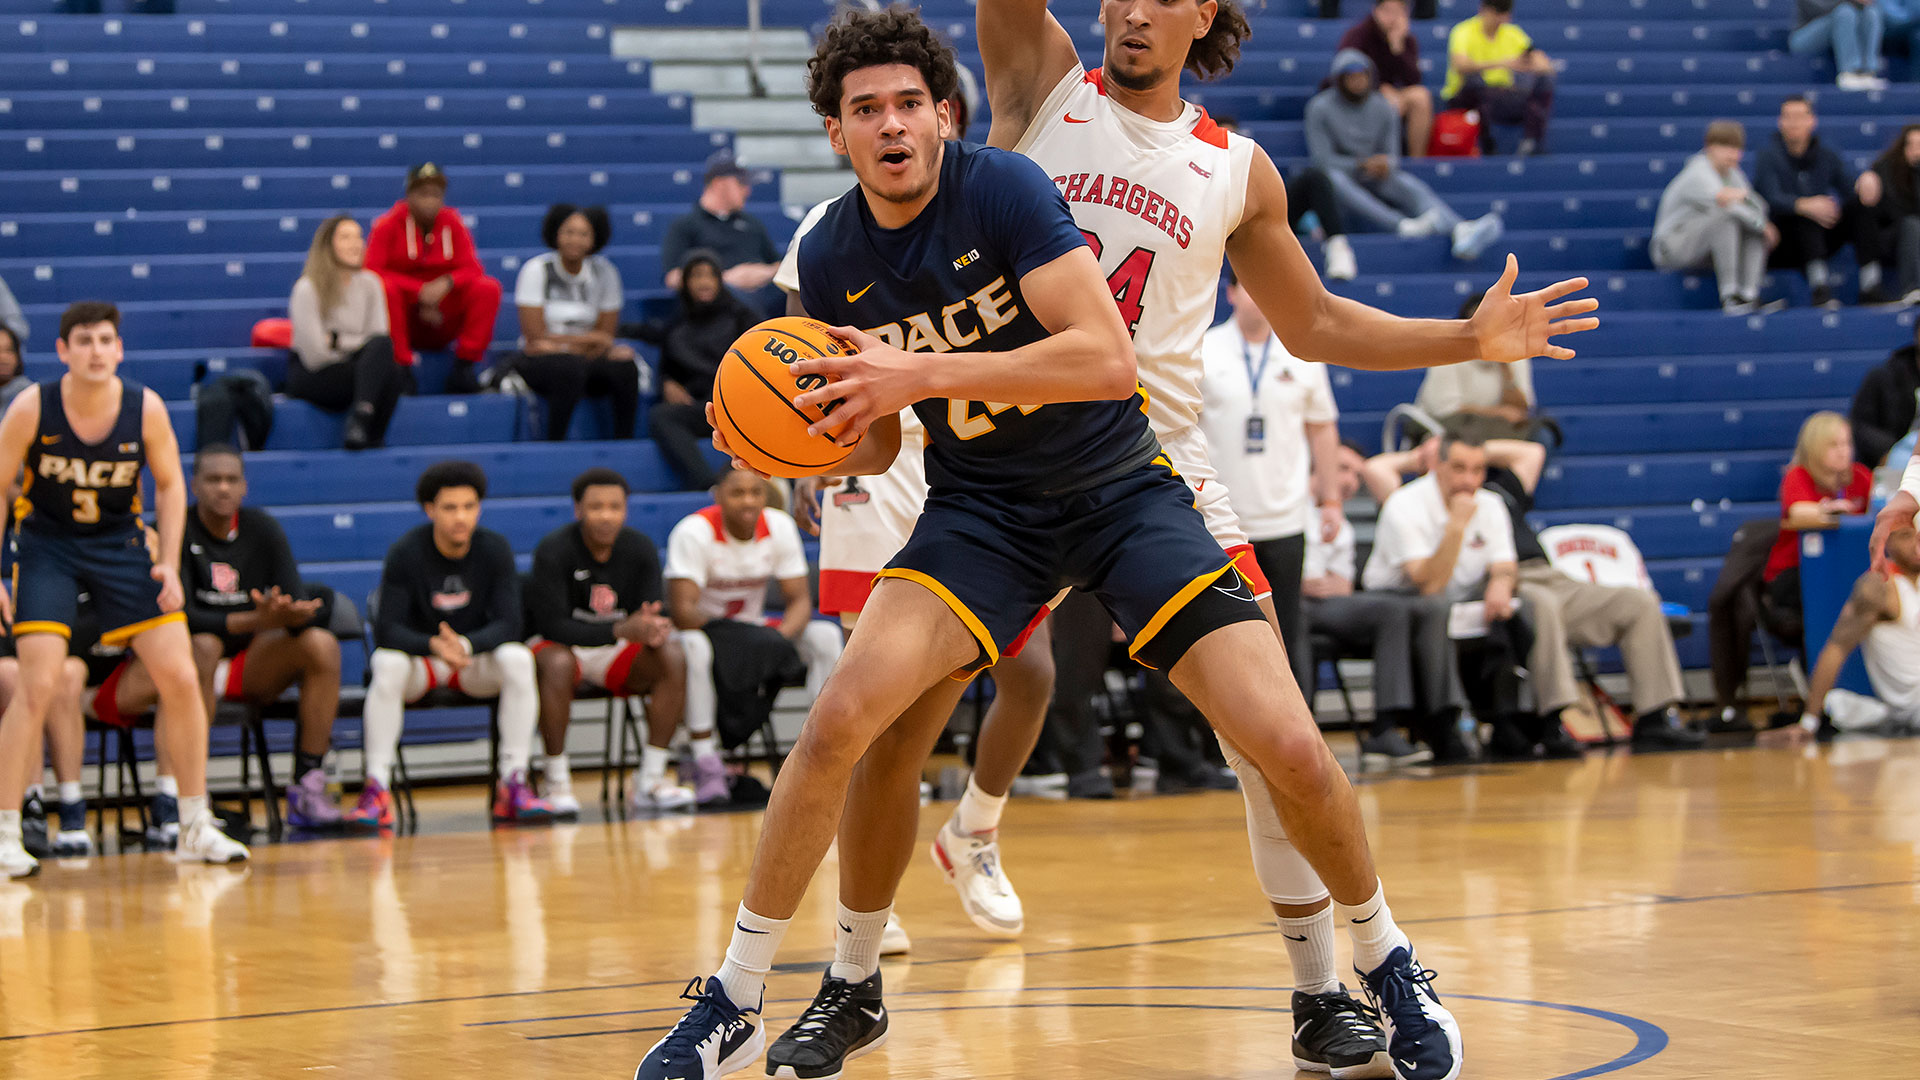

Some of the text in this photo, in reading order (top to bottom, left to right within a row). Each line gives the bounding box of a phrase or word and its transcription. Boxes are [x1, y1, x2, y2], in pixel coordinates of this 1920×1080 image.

[952, 248, 981, 271] NE10
[1078, 227, 1156, 341] 4
[861, 274, 1020, 354] PACE
[38, 452, 140, 489] PACE
[71, 488, 101, 525] 3
